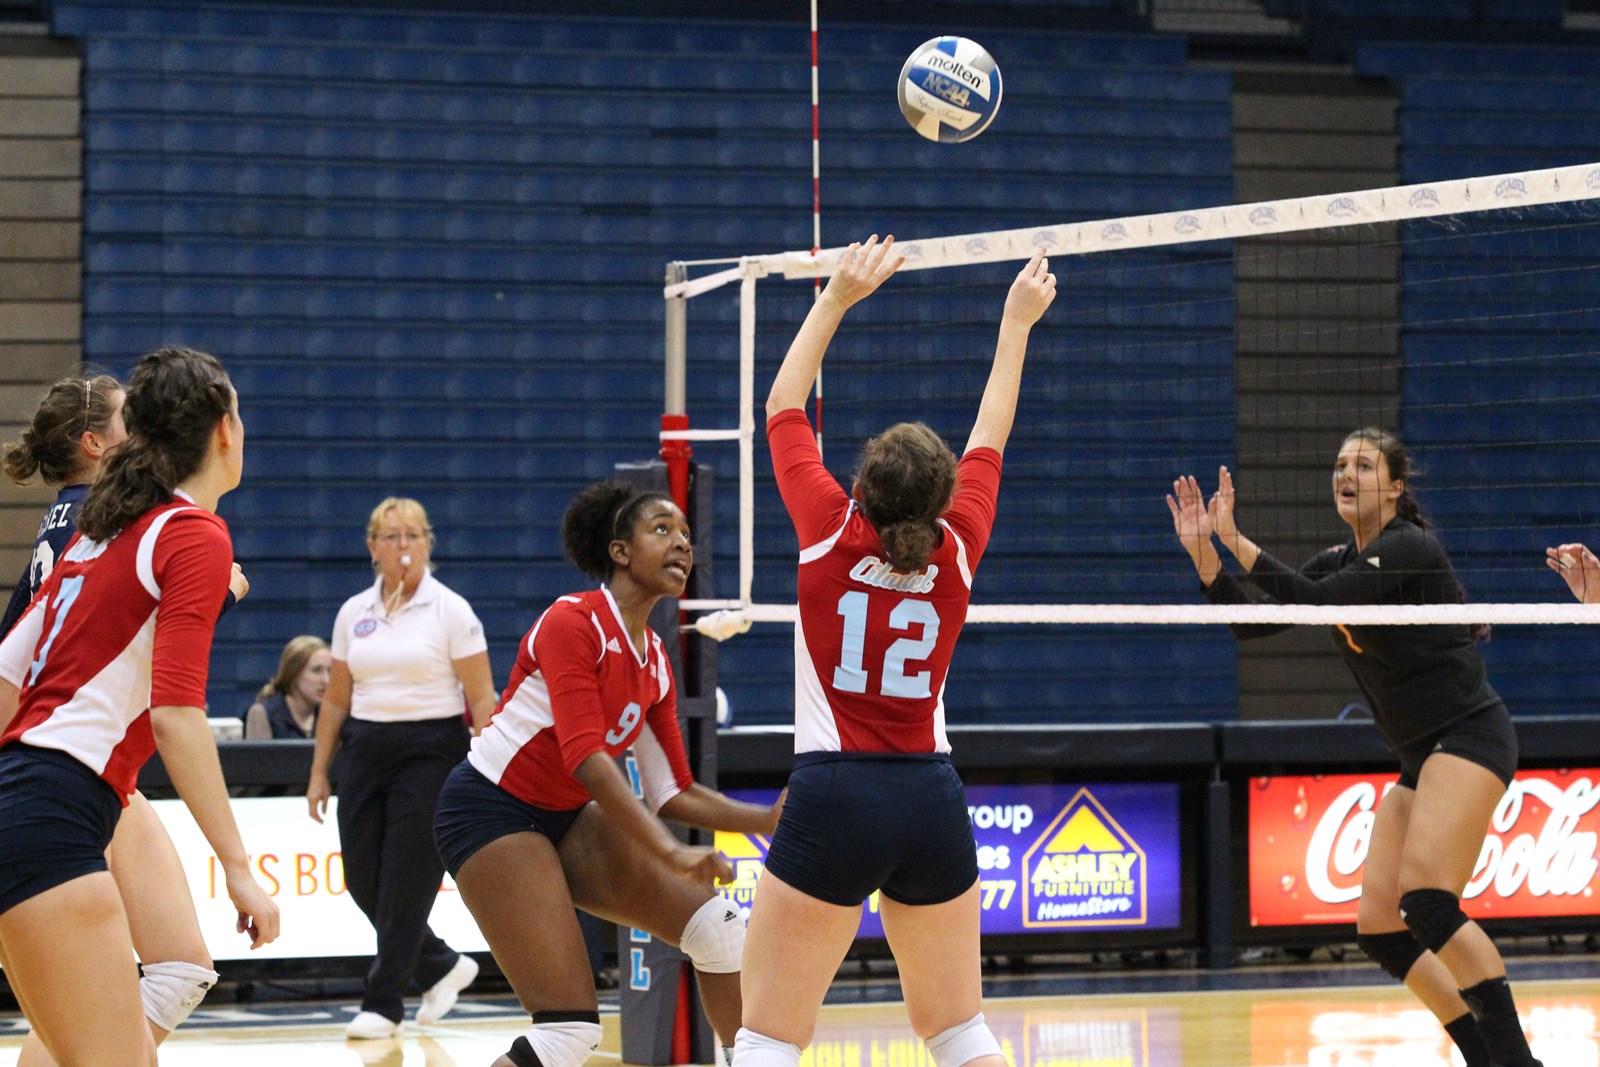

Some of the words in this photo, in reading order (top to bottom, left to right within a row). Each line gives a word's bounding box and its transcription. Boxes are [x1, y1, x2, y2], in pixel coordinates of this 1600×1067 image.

[927, 55, 982, 89] molten
[921, 71, 970, 108] NCAA
[1494, 177, 1528, 197] CITADEL
[849, 556, 939, 594] Citadel
[28, 575, 85, 688] 7
[832, 590, 941, 699] 12
[605, 701, 641, 745] 9
[967, 804, 1034, 835] roup
[1031, 852, 1138, 884] ASHLEY
[980, 879, 1017, 910] 77
[1033, 879, 1136, 898] FURNITURE
[1036, 896, 1133, 921] HomeStore
